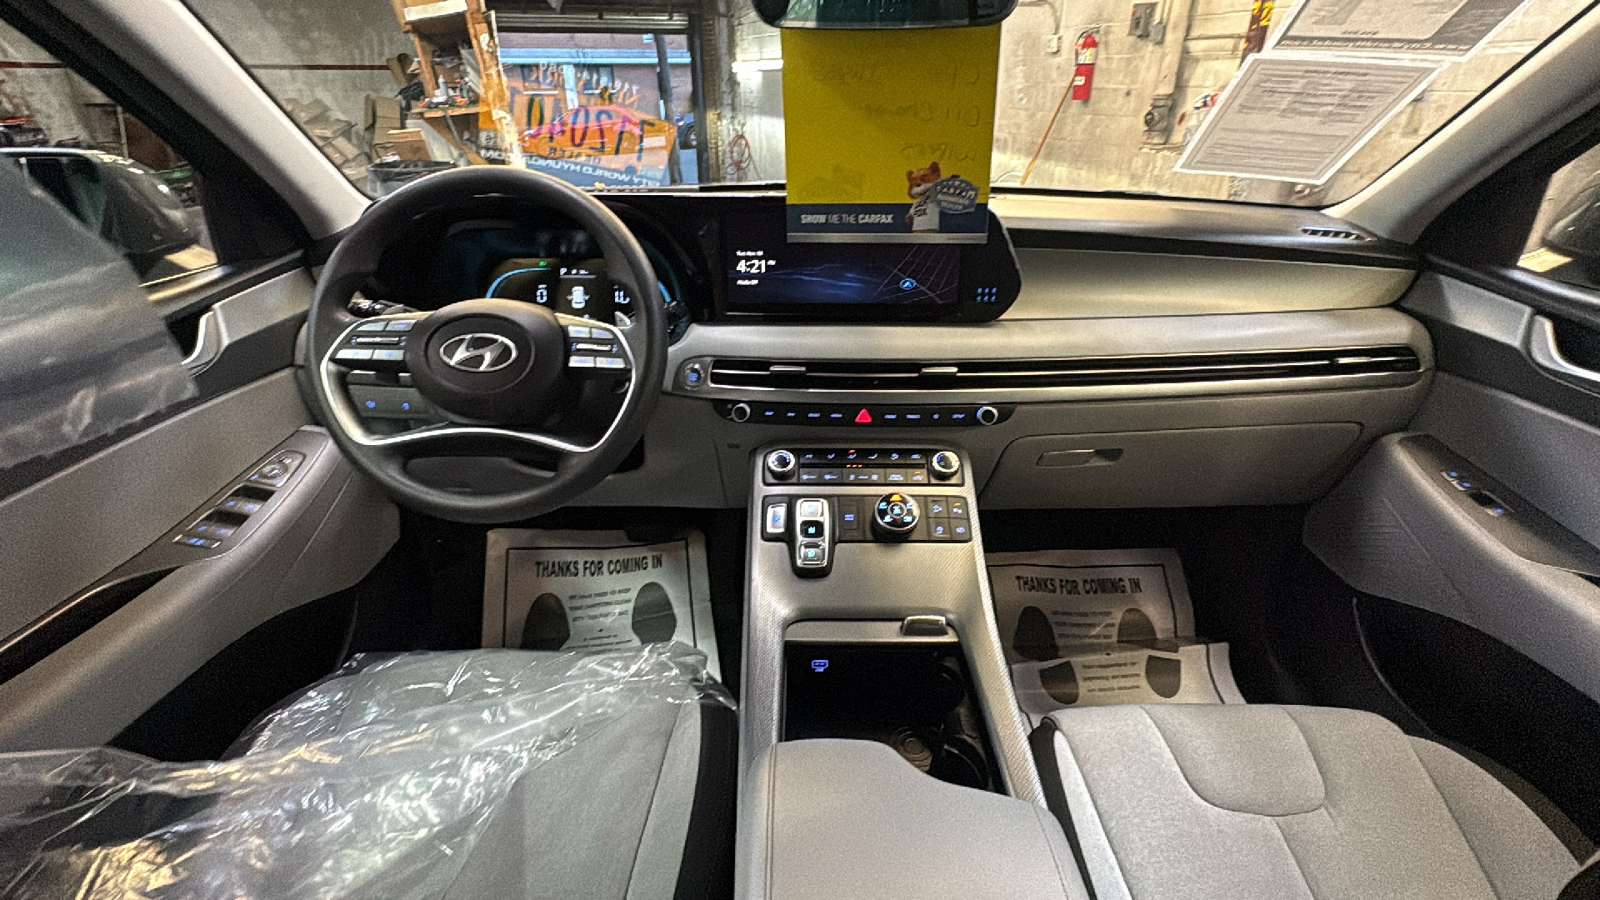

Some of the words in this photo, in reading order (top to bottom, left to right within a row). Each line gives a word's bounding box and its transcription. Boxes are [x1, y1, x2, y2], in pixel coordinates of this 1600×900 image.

[801, 214, 827, 224] SHOW
[828, 214, 841, 224] ME
[842, 214, 857, 224] THE
[858, 214, 894, 224] CARFAX
[736, 259, 766, 274] 4:21
[535, 560, 579, 578] THANKS
[583, 560, 604, 577] FOR
[607, 555, 648, 576] COMING
[651, 553, 662, 569] IN
[1015, 575, 1057, 594] THANKS
[1060, 577, 1081, 595] FOR
[1083, 576, 1126, 595] COMING
[1128, 576, 1143, 594] IN
